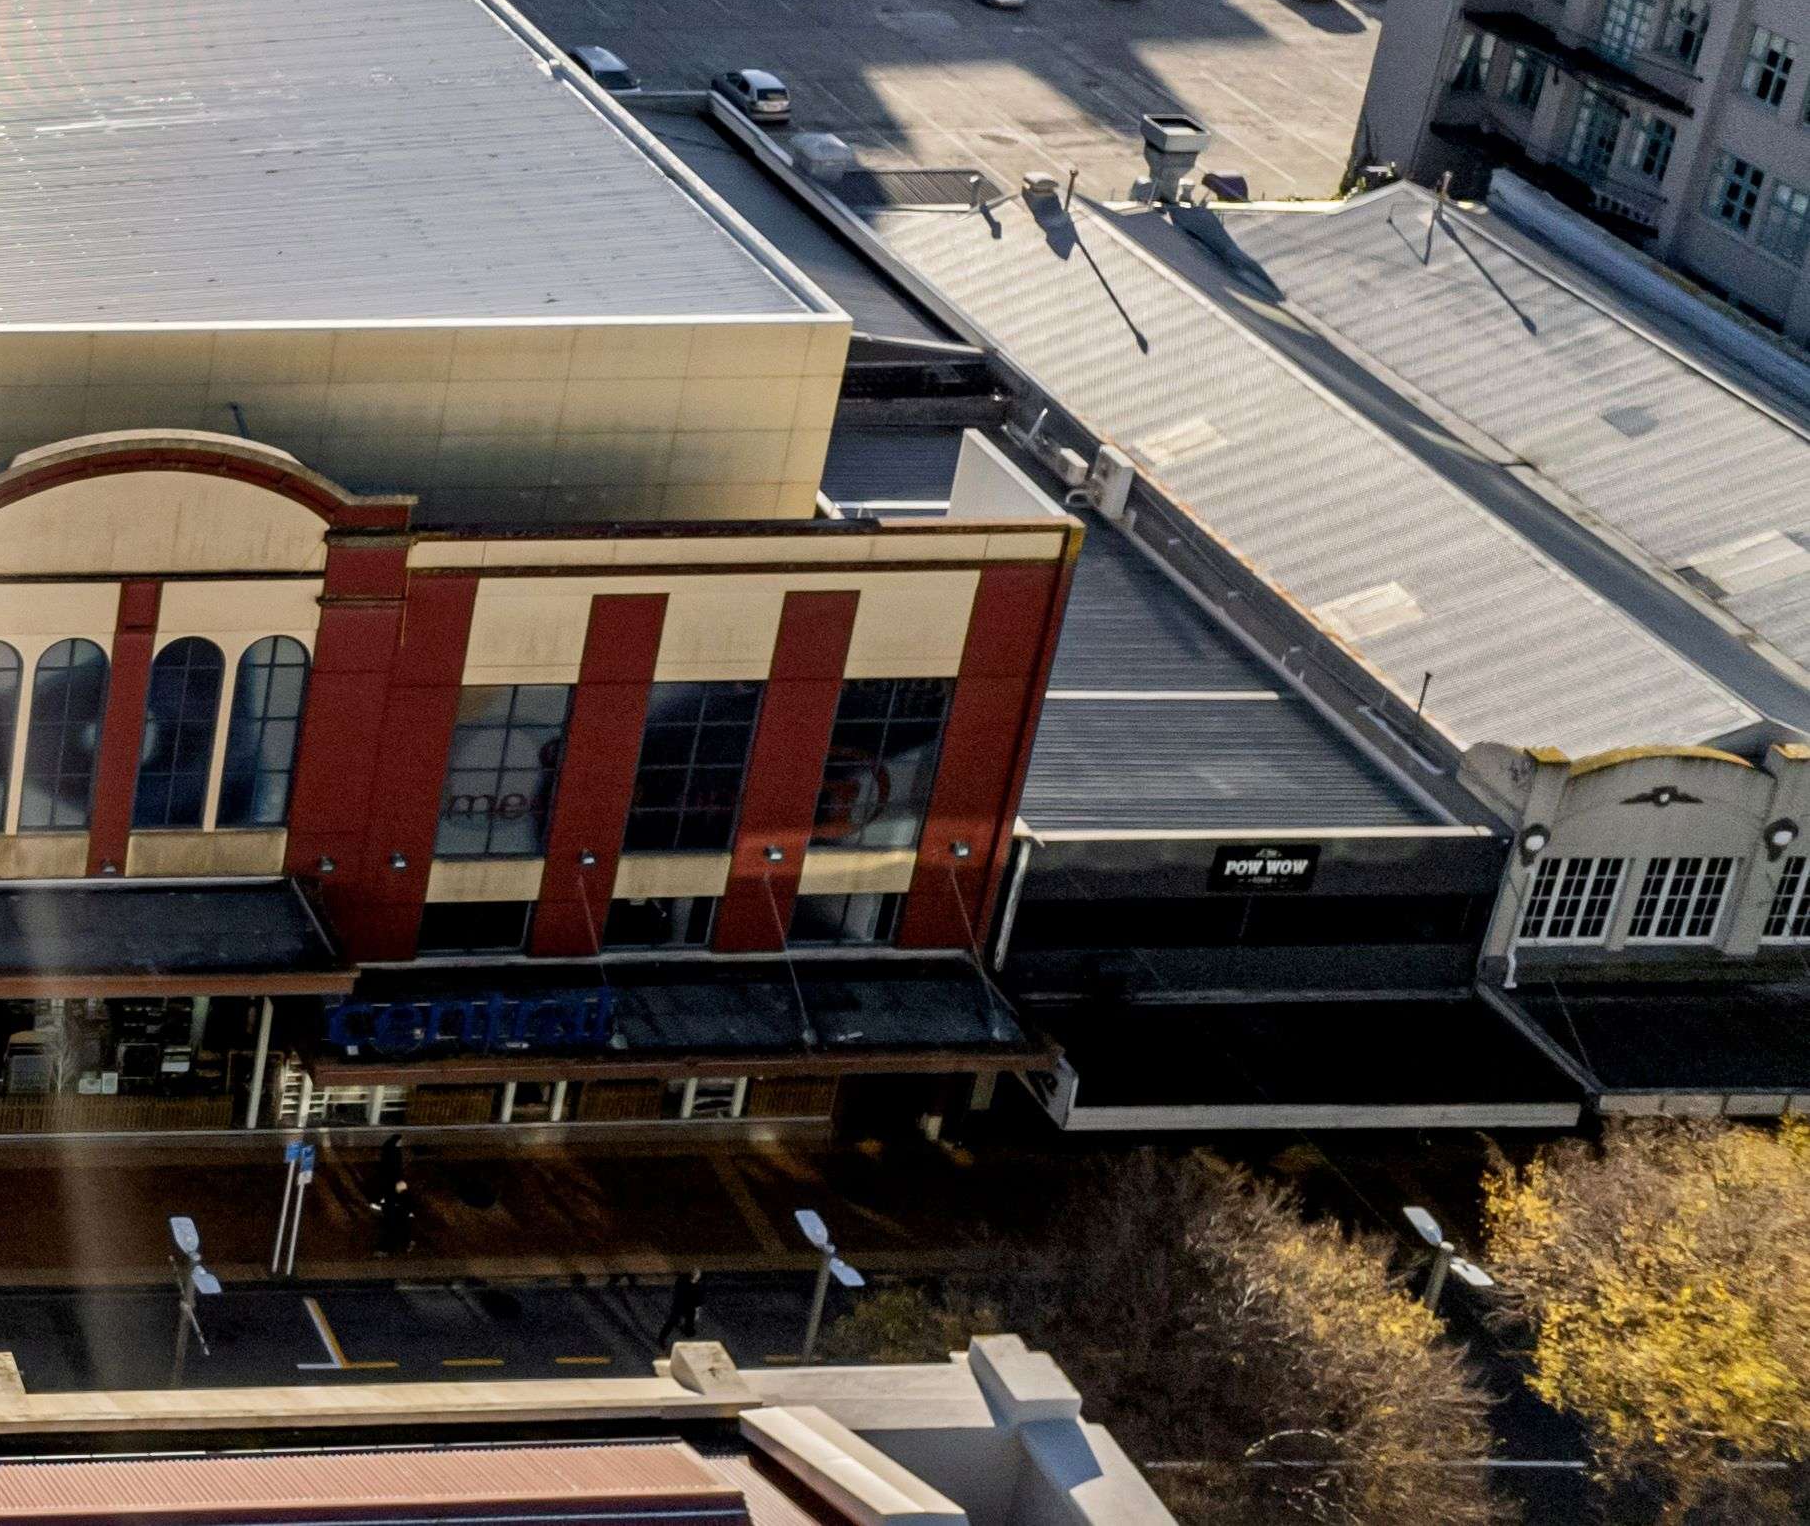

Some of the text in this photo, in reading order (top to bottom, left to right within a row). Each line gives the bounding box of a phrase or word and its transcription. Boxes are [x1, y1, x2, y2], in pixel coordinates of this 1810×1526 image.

[1224, 859, 1309, 876] POW WOW
[326, 986, 616, 1055] central
